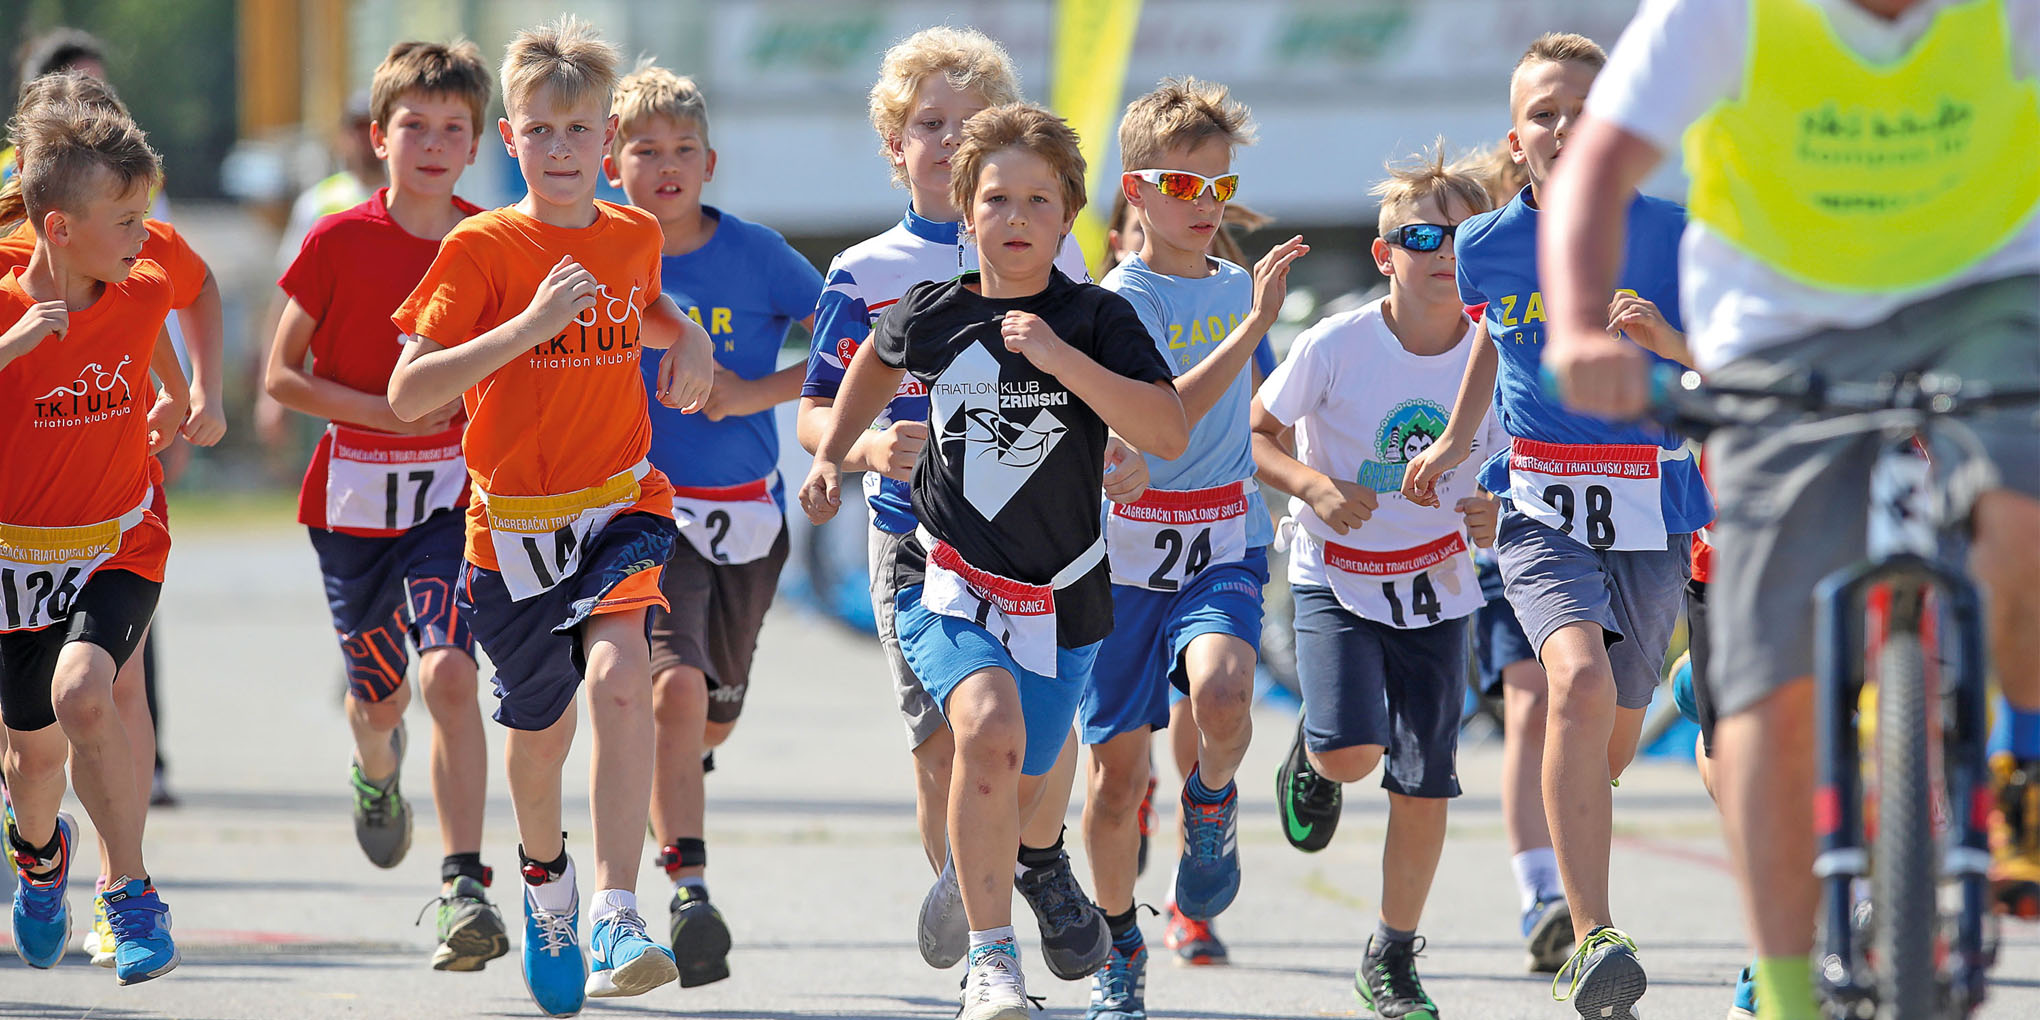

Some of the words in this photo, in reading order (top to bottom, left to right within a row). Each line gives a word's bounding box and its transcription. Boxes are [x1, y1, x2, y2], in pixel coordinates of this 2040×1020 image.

[1168, 312, 1248, 350] ZADA
[529, 357, 591, 369] triatlon
[595, 352, 624, 366] klub
[935, 382, 998, 395] TRIATLON
[1000, 380, 1040, 394] KLUB
[1000, 391, 1069, 409] ZRINSKI
[34, 418, 82, 429] triatlon
[84, 411, 109, 425] klub
[1623, 463, 1652, 477] SAVEZ
[385, 469, 434, 529] 17
[1119, 503, 1172, 523] ZAGREBAČKI
[1543, 484, 1616, 550] 28
[493, 516, 549, 531] ZAGREBAČKI
[29, 547, 85, 562] TRIATLONSKI
[1148, 527, 1212, 591] 24
[2, 566, 82, 630] 126
[1019, 599, 1047, 614] SAVEZ
[1382, 570, 1442, 628] 14
